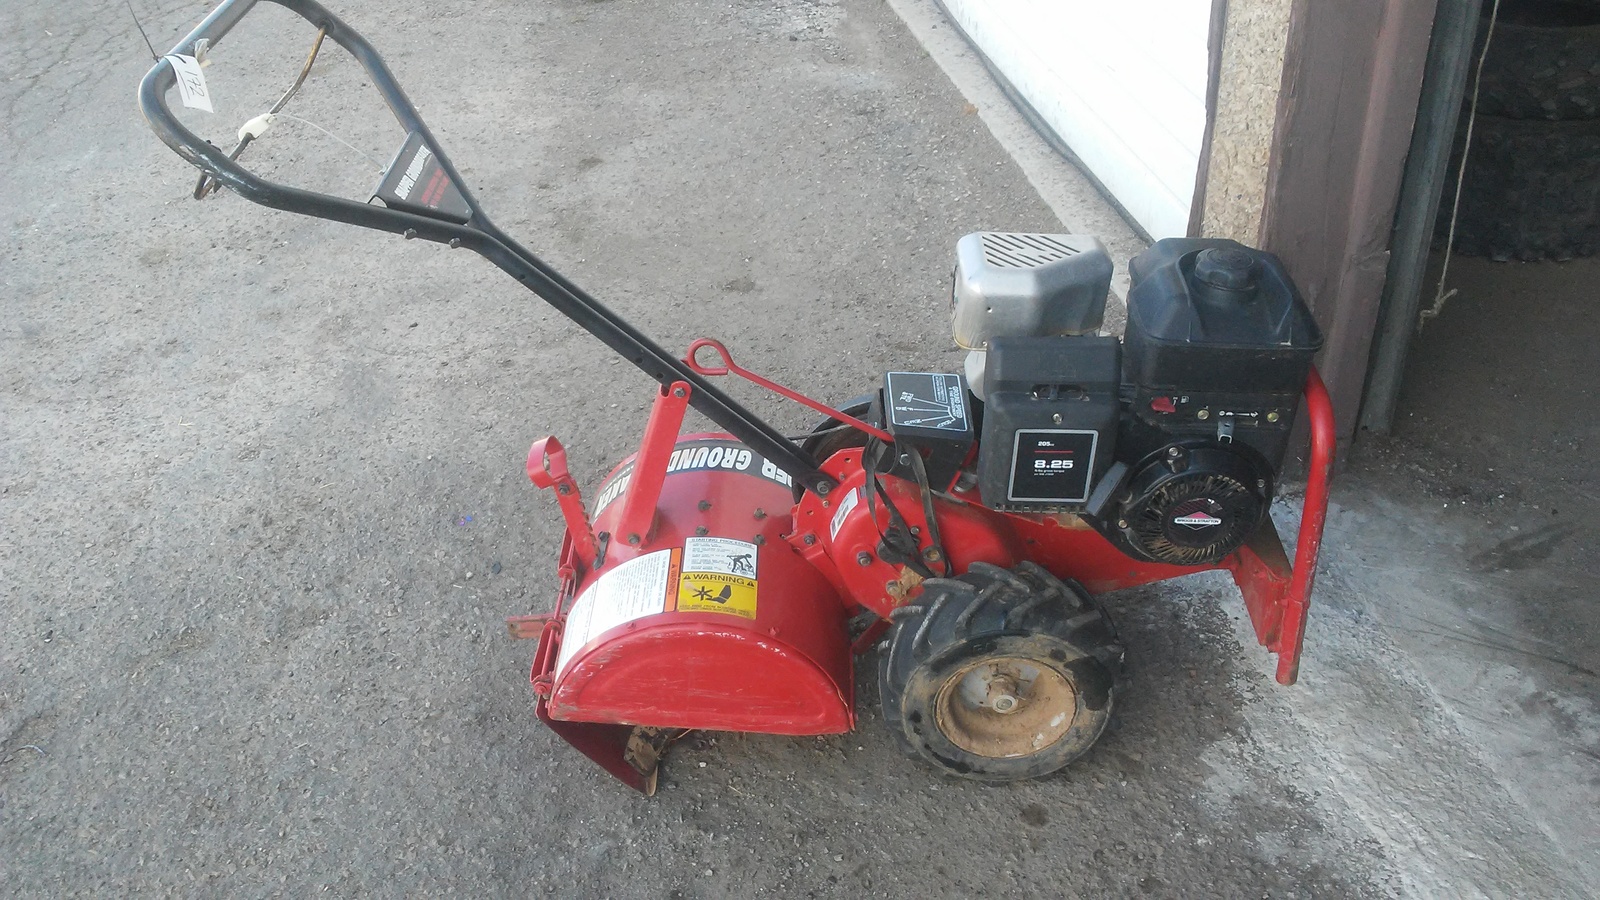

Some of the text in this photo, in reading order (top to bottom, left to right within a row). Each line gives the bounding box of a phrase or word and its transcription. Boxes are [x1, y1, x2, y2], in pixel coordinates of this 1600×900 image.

[184, 70, 205, 97] 172
[666, 446, 752, 477] GROUND
[1034, 459, 1073, 469] 8.25
[693, 573, 745, 585] WARNING
